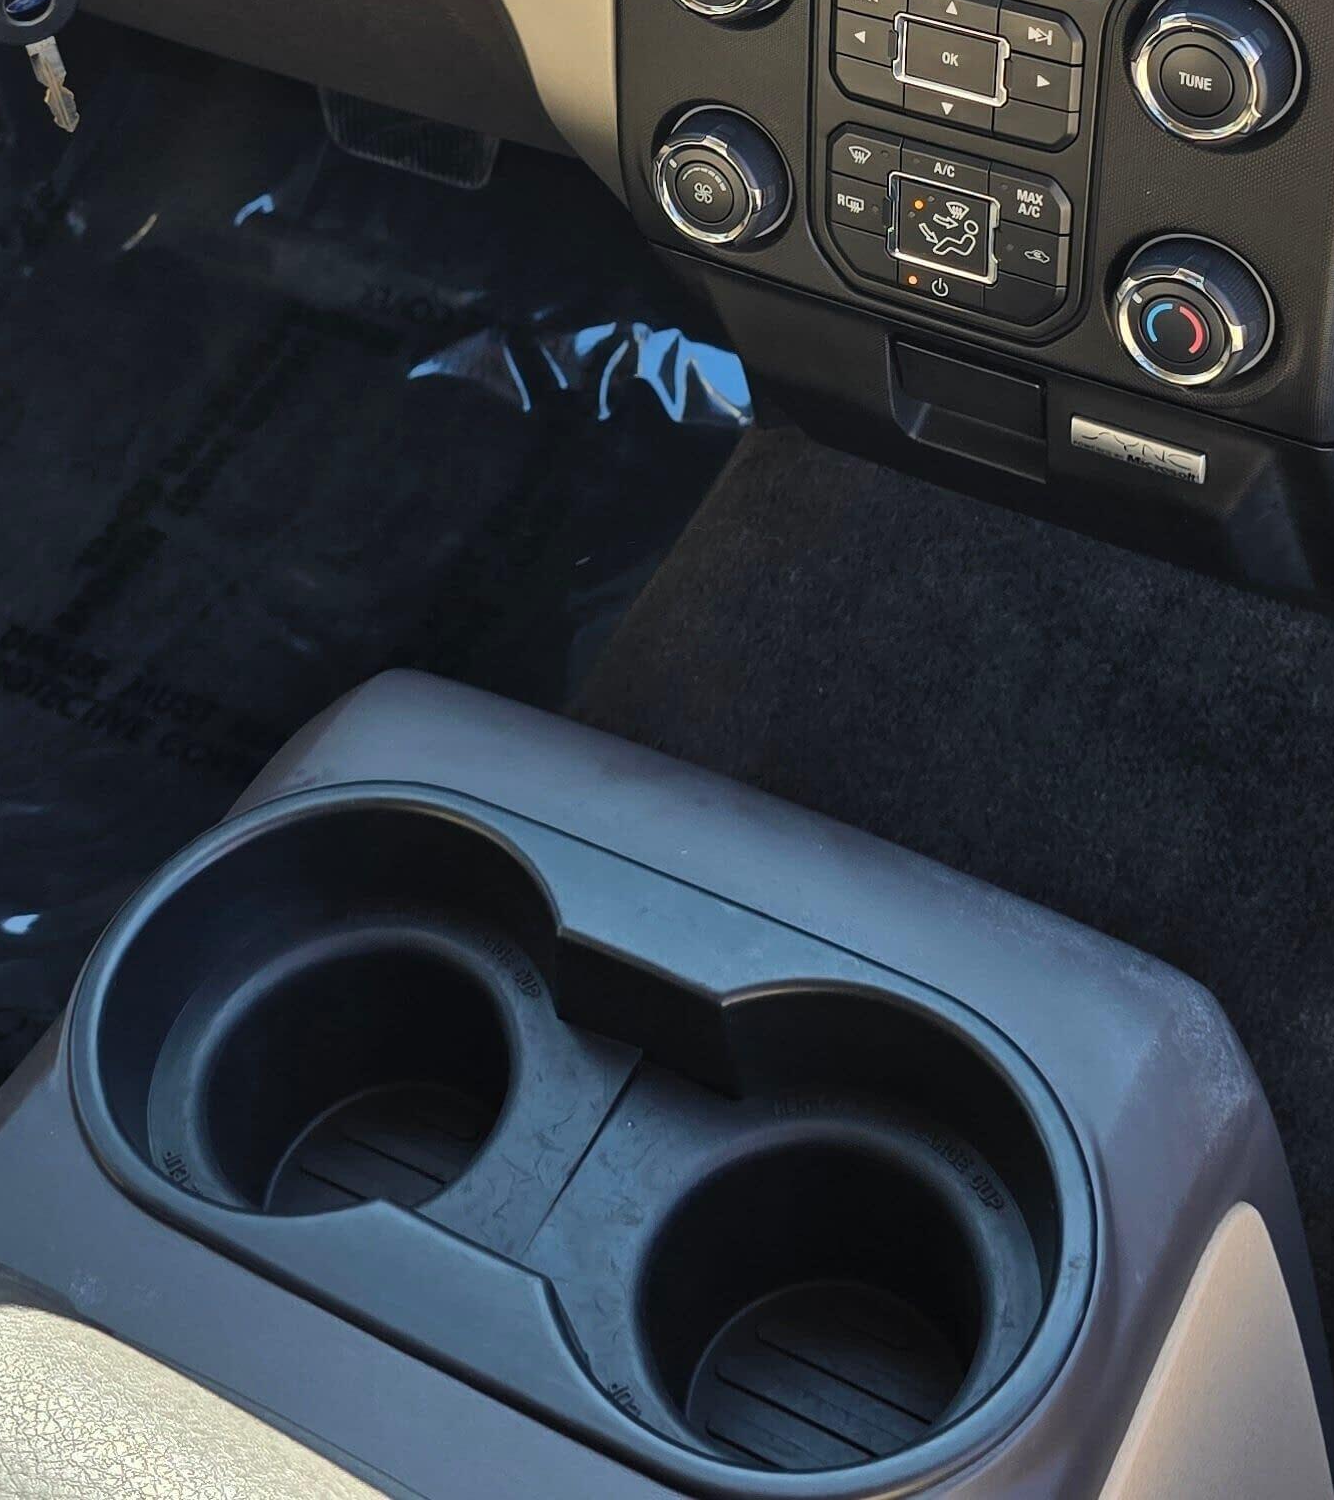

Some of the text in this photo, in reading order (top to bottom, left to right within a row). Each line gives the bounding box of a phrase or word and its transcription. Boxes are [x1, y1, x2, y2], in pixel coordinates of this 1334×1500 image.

[941, 51, 959, 67] OK
[1178, 71, 1213, 91] TUNE
[933, 162, 956, 178] A/C
[1016, 188, 1044, 206] MAX
[1017, 203, 1041, 219] A/C
[1081, 431, 1193, 471] SYNC
